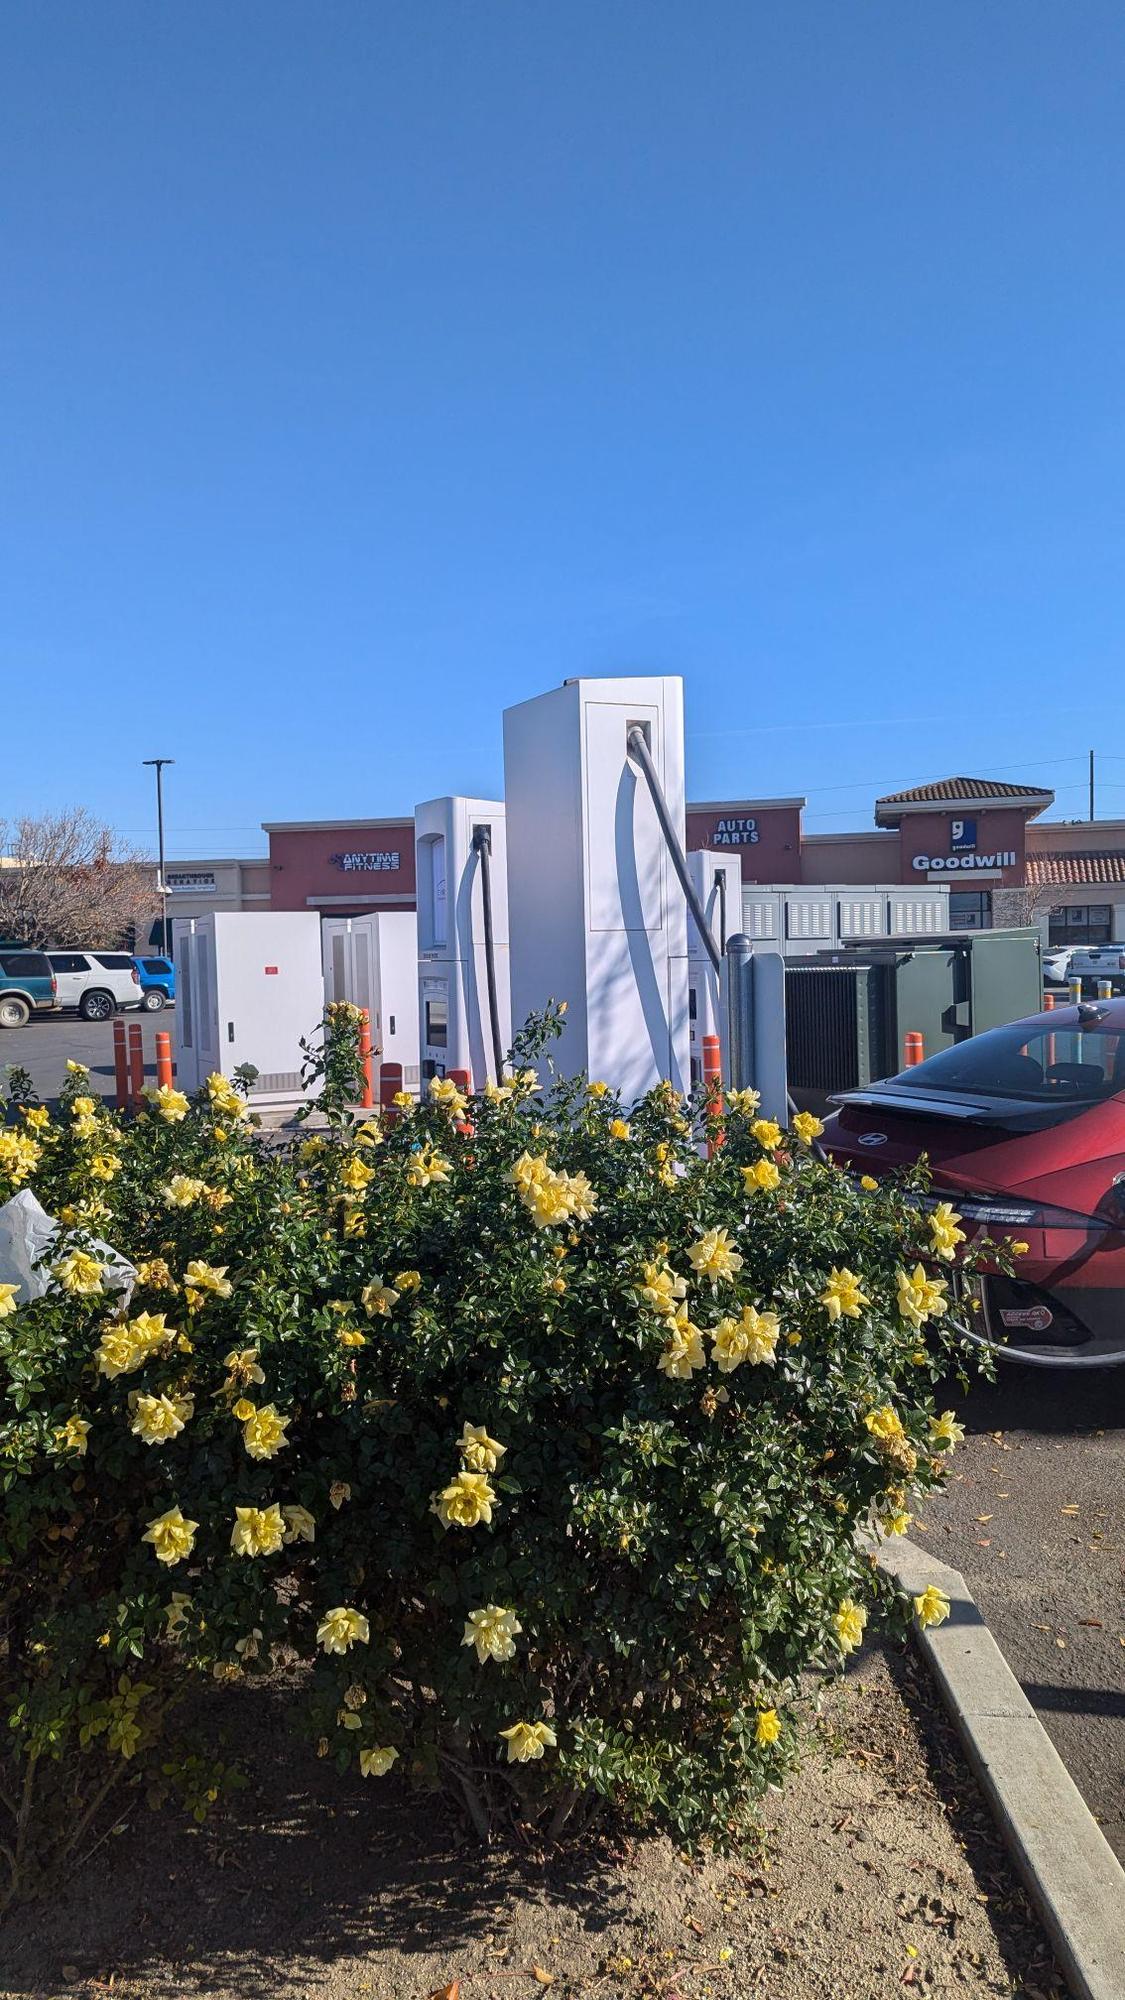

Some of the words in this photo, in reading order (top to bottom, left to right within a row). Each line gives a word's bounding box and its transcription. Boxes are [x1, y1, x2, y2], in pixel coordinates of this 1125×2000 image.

[718, 819, 756, 832] AUTO
[713, 831, 759, 845] PARTS
[343, 852, 400, 863] ANYTIME
[912, 852, 1016, 870] Goodwill
[344, 862, 400, 871] FITNESS
